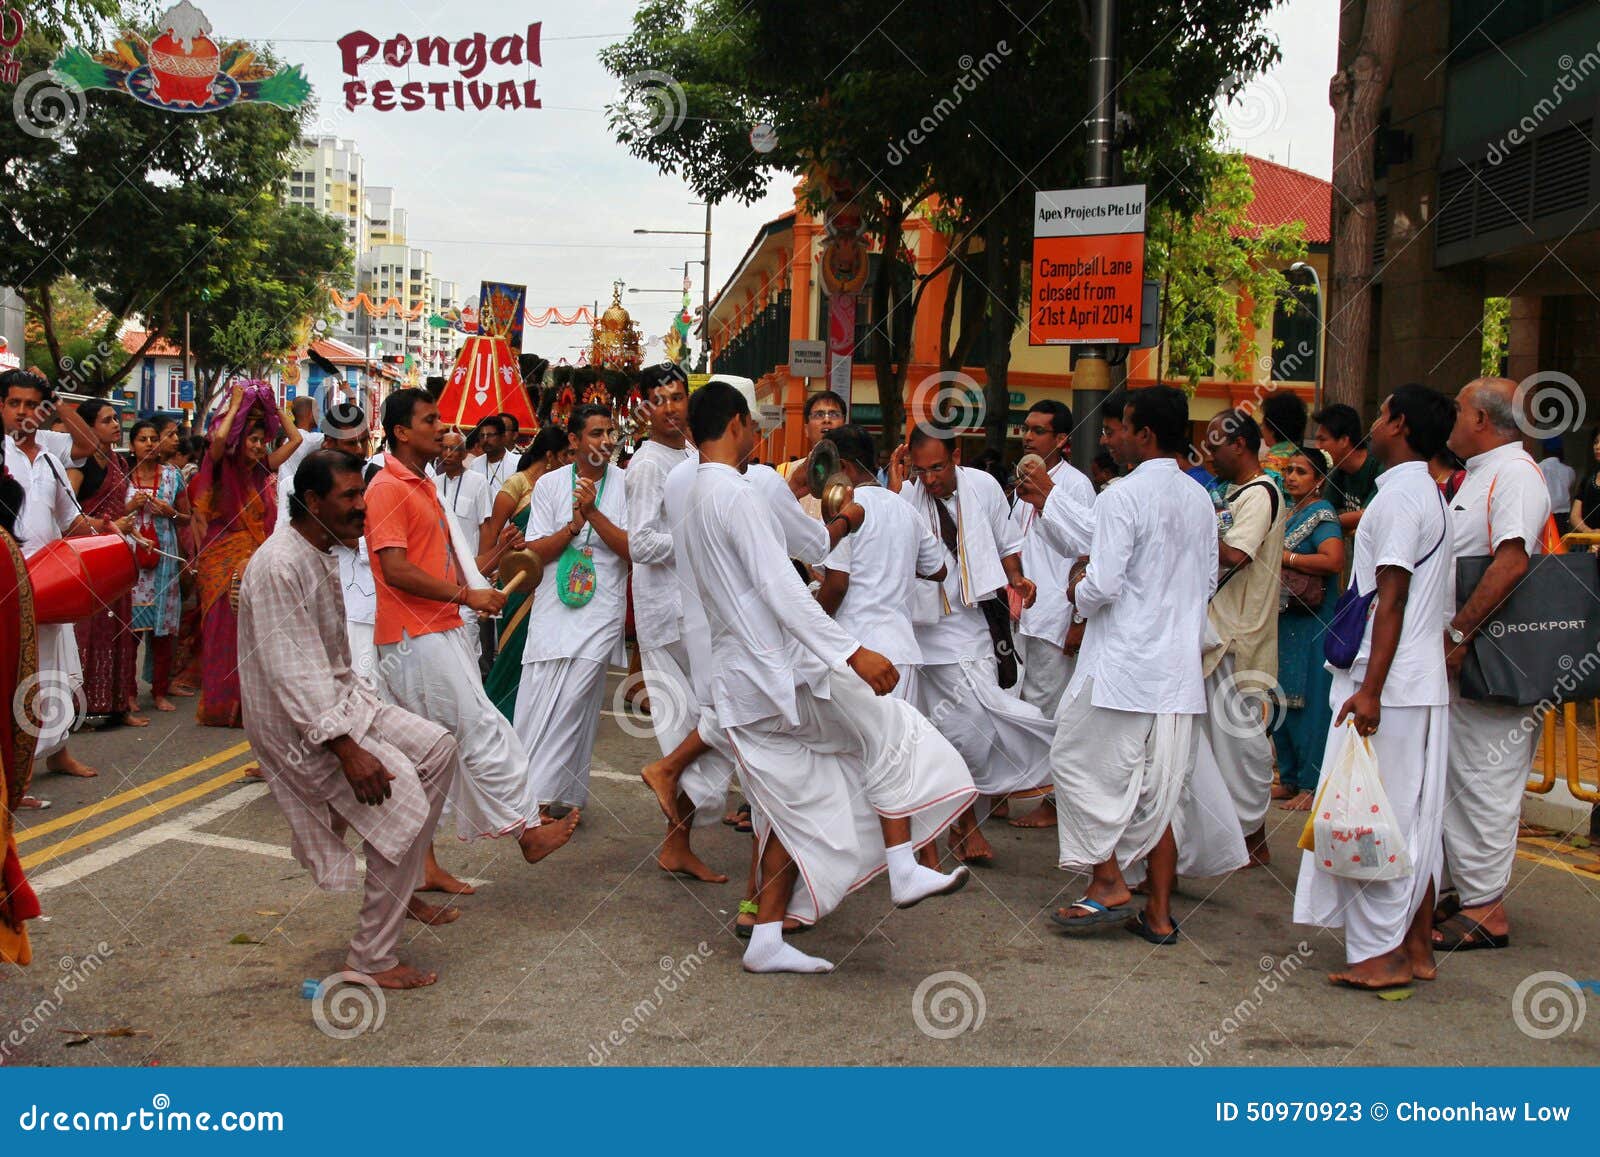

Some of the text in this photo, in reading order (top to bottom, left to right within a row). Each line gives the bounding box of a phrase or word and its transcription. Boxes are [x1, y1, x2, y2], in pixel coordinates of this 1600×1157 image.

[337, 22, 542, 78] Pongal
[343, 79, 542, 112] FESTIVAL
[1038, 202, 1142, 223] Apex Projects Pte Ltd
[1039, 256, 1133, 281] Campbell Lane
[1039, 282, 1116, 302] closed from
[1038, 305, 1133, 331] 21st April 2014
[1507, 620, 1587, 633] ROCKPORT
